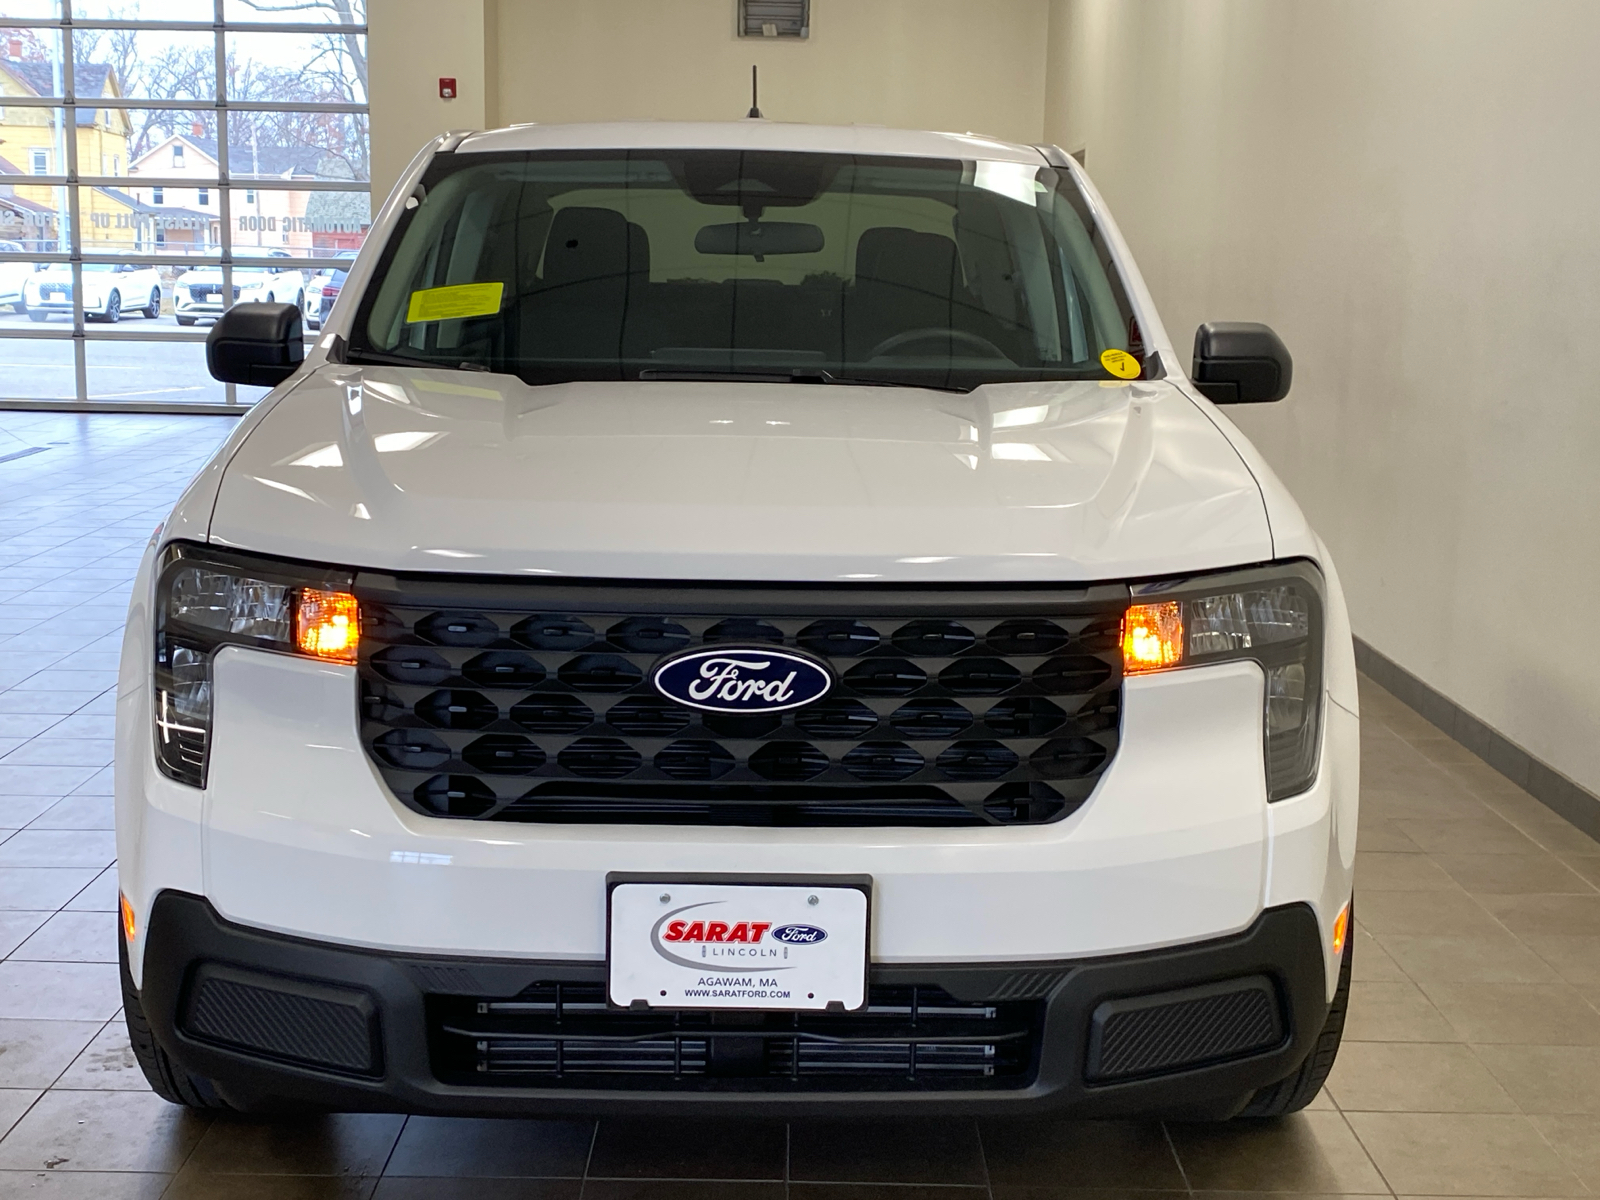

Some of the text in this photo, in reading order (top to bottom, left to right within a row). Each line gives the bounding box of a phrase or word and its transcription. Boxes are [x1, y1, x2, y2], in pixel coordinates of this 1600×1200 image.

[688, 658, 797, 702] Ford
[663, 920, 818, 943] SARAT Ford
[712, 947, 777, 957] LINCOLN
[697, 977, 778, 988] AGAWAM, MA
[684, 989, 791, 998] WWW.SARATFORD.COM
